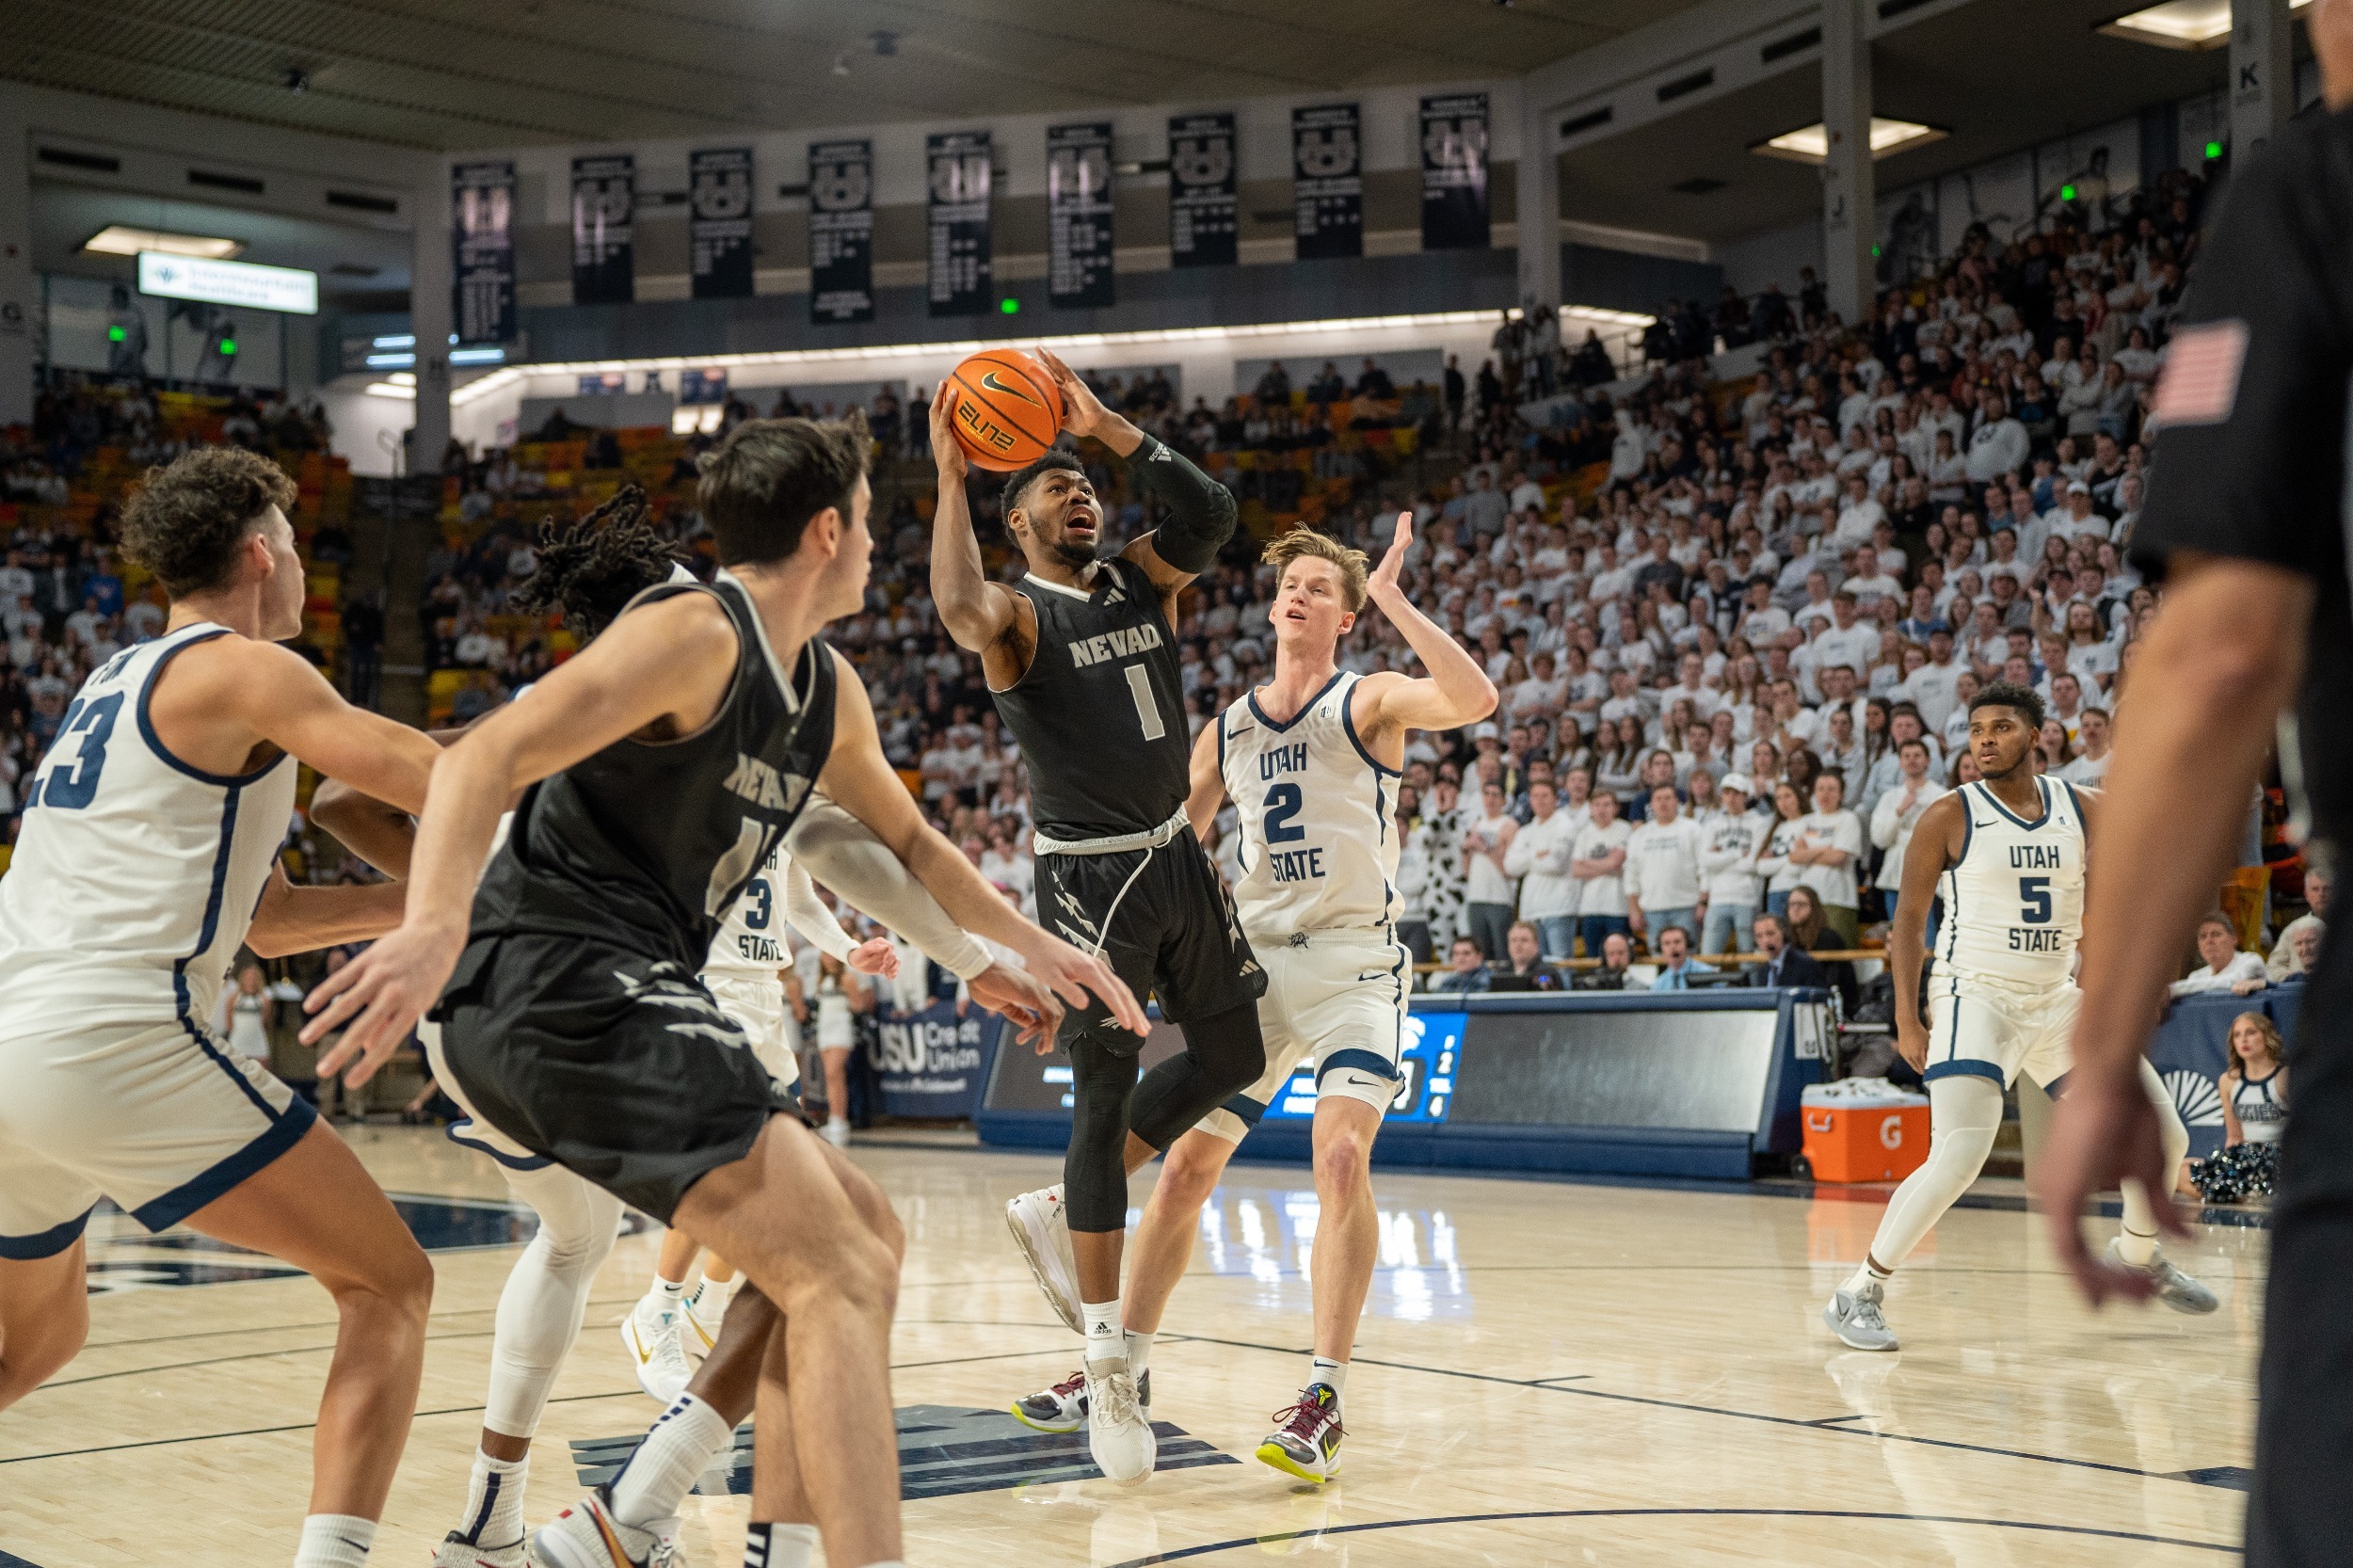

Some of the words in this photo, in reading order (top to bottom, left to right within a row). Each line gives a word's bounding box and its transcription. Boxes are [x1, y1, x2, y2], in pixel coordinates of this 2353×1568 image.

[958, 400, 1016, 450] ELITE
[1068, 623, 1163, 668] NEVAD
[1124, 663, 1166, 742] 1
[1259, 742, 1307, 781] UTAH
[1262, 782, 1305, 845] 2
[1269, 847, 1326, 883] STATE
[2009, 845, 2060, 869] UTAH
[745, 878, 772, 931] 3
[2019, 876, 2052, 924] 5
[2009, 928, 2062, 952] STATE
[866, 1022, 926, 1073] USU
[1880, 1114, 1902, 1150] G
